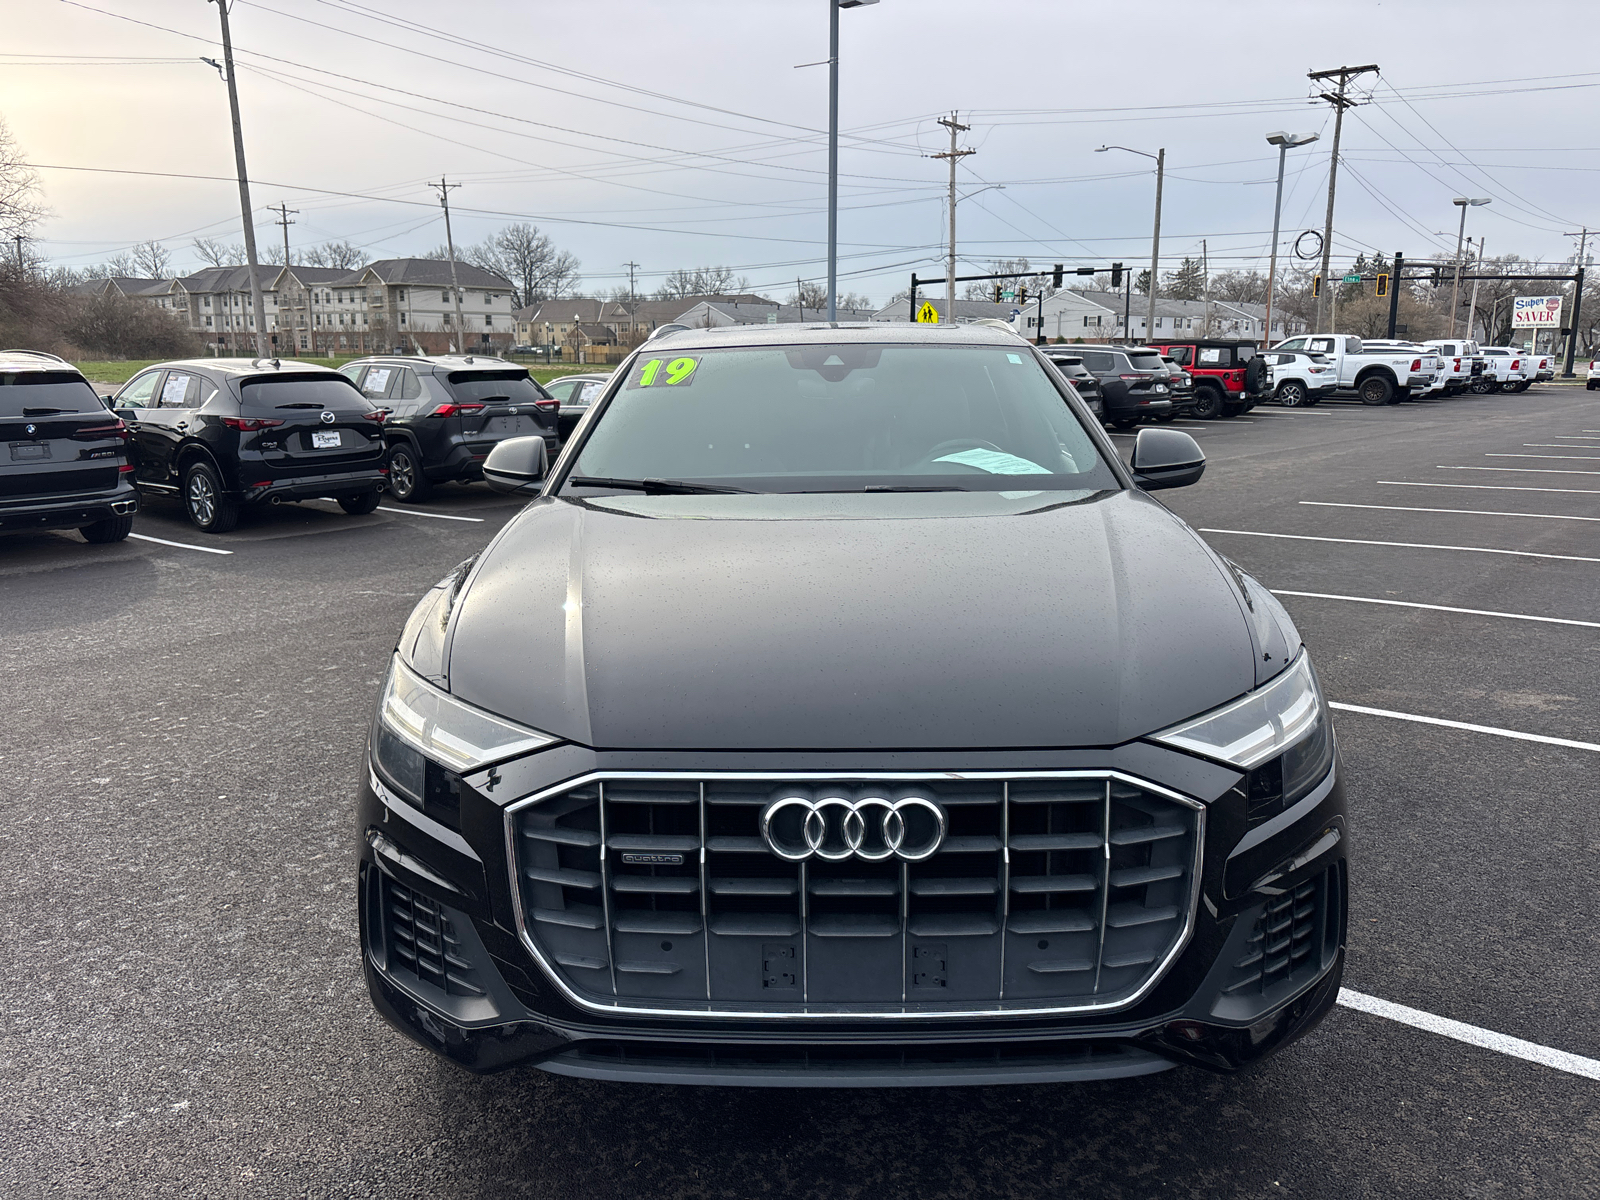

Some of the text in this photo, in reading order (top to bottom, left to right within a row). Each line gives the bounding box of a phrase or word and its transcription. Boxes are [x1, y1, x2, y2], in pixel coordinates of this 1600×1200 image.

[1516, 298, 1544, 309] Super
[1515, 311, 1554, 323] SAVER
[639, 357, 698, 387] 19
[625, 855, 680, 863] quattro
